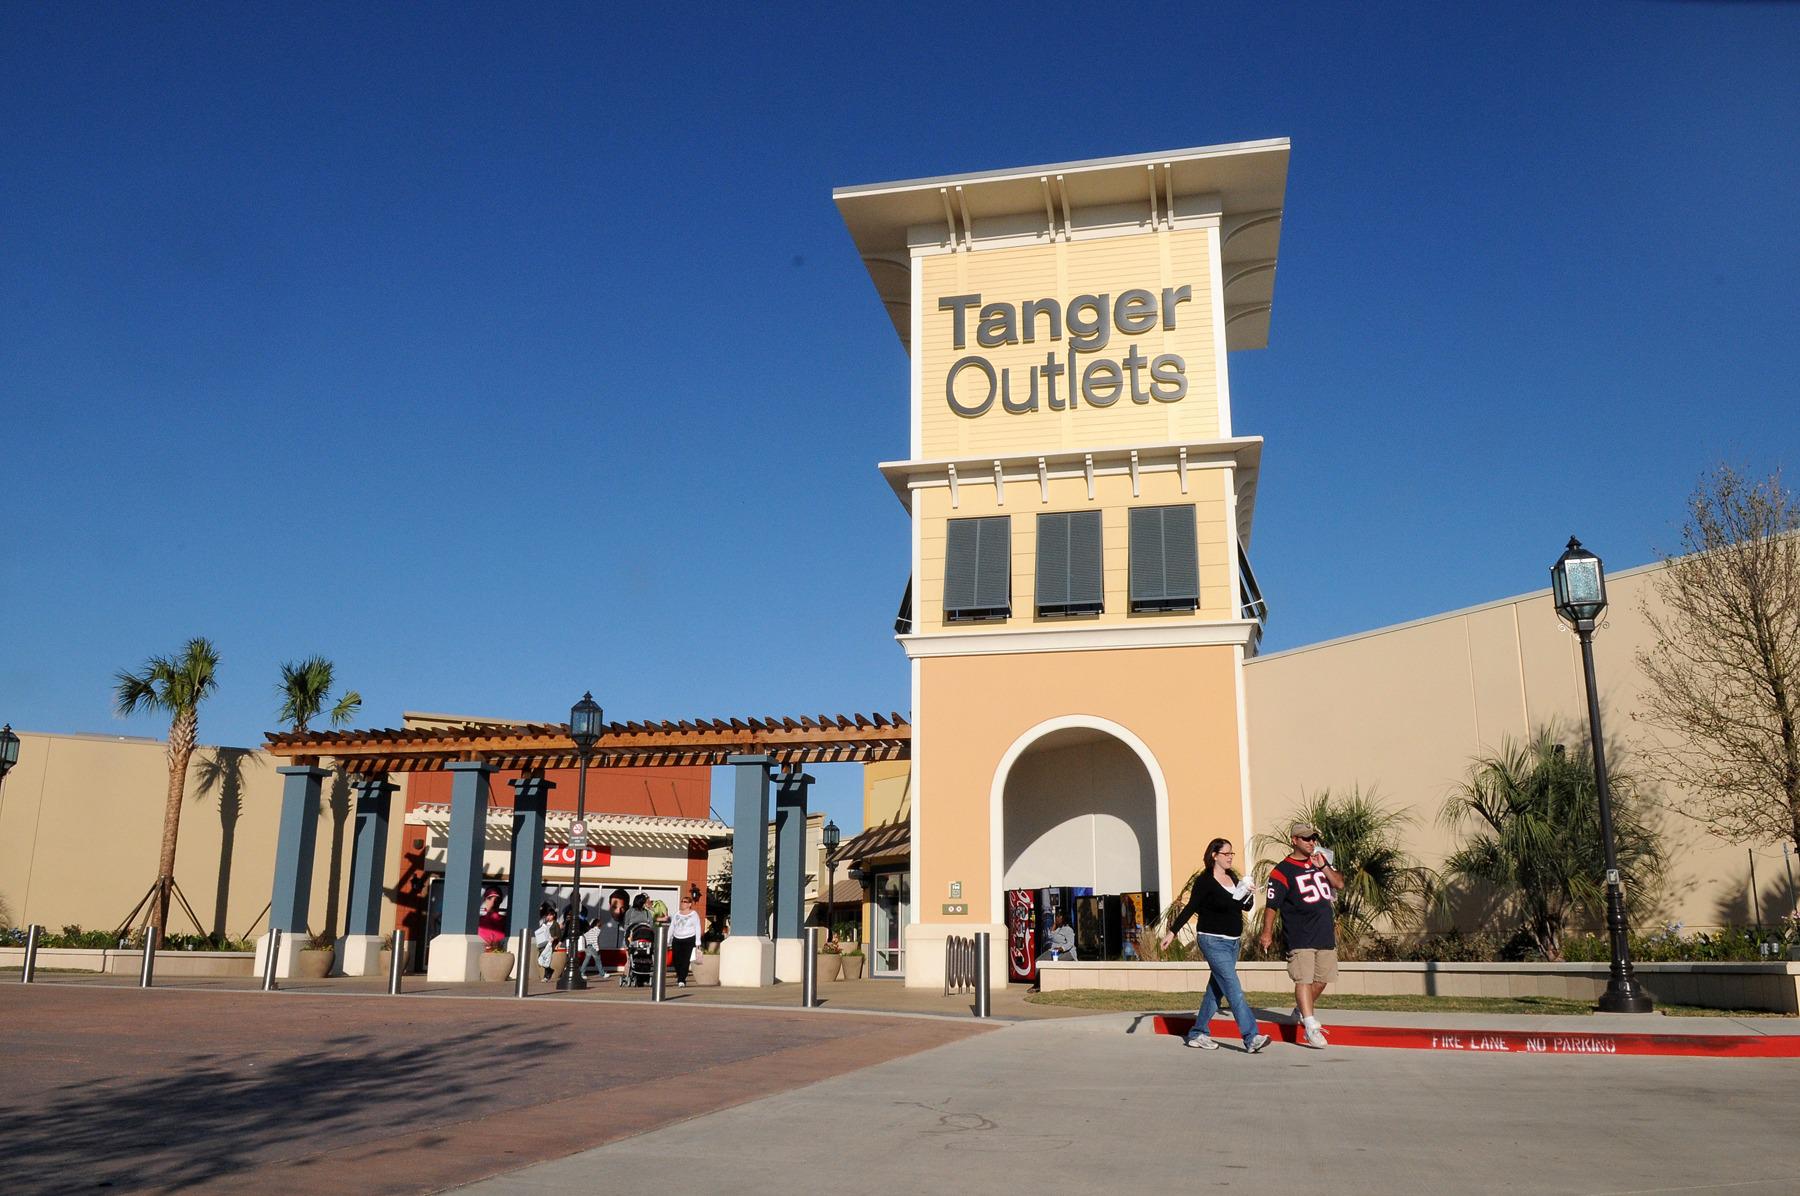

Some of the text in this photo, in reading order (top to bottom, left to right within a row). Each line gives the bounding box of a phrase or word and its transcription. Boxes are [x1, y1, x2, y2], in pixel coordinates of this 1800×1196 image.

[938, 285, 1192, 353] Tanger
[946, 344, 1189, 419] Outlets
[543, 845, 597, 862] ZOD
[1296, 871, 1331, 903] 56
[1432, 1035, 1616, 1053] FIRE LANE NO PARKING
